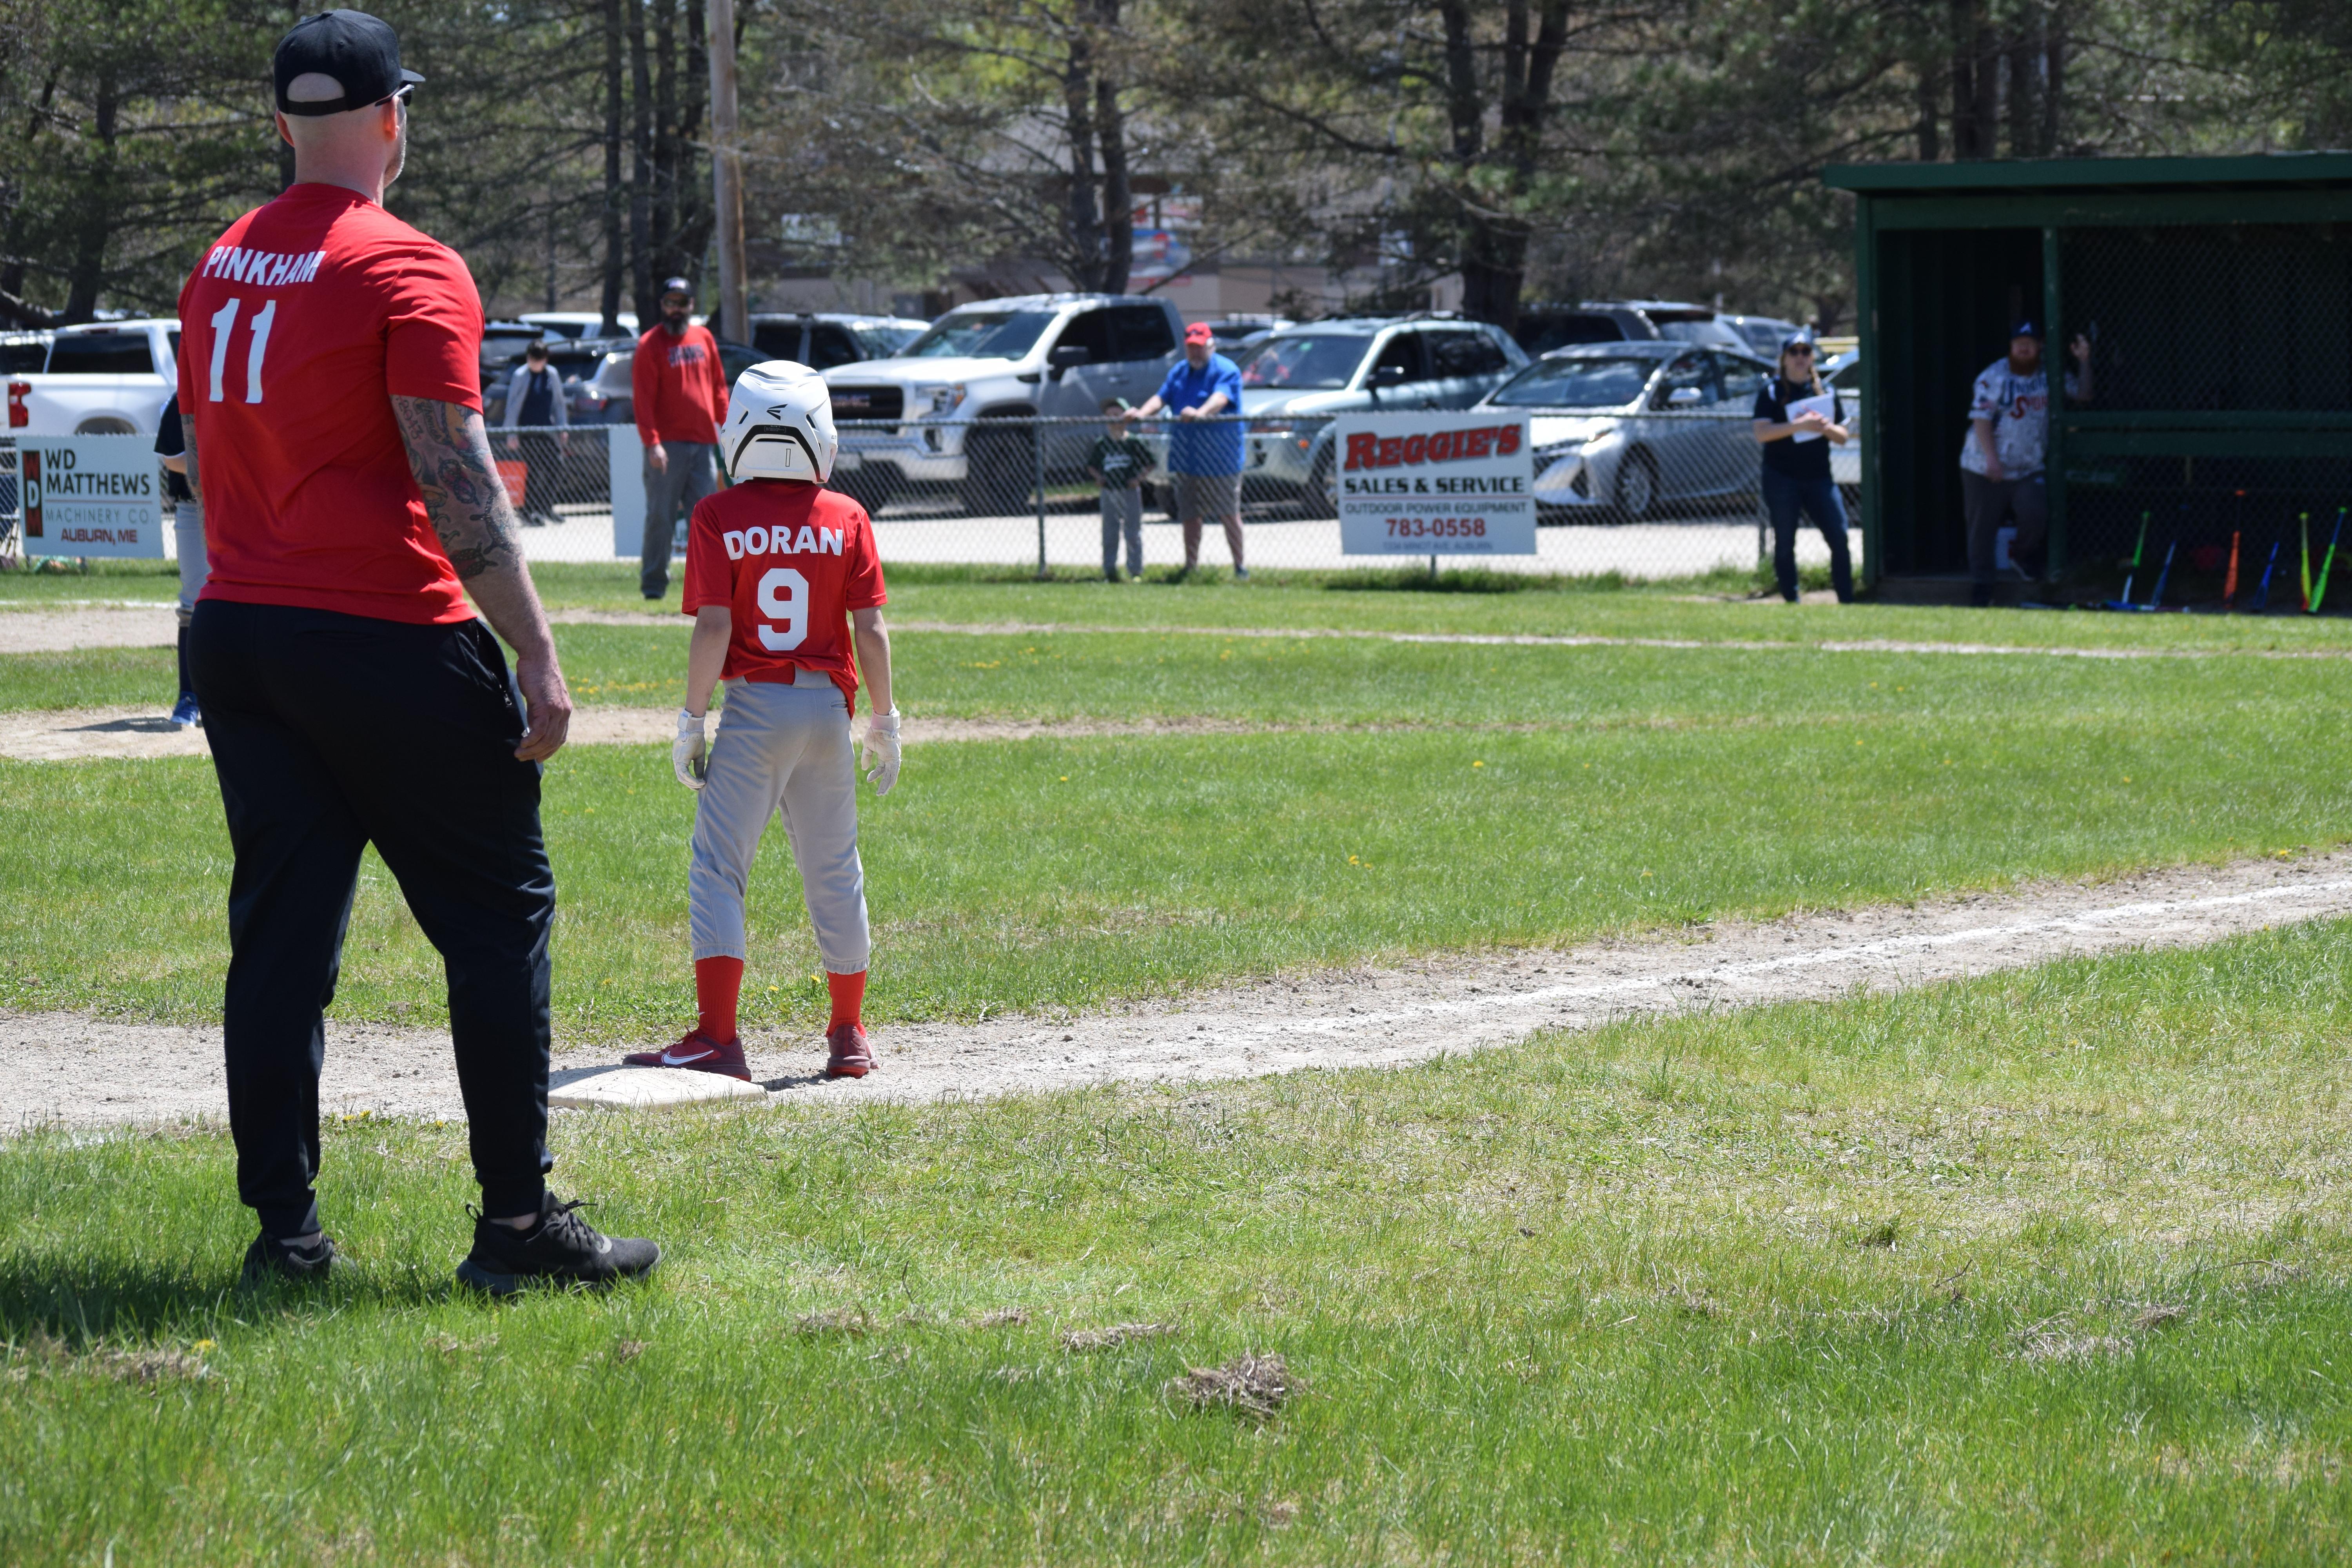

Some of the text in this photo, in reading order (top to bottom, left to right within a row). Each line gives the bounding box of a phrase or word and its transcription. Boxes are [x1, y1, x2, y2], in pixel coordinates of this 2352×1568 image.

[202, 246, 327, 285] PINKHAM
[209, 298, 276, 403] 11
[1345, 423, 1521, 470] REGGIE'S
[45, 449, 76, 469] WD
[46, 473, 151, 495] MATTHEWS
[1345, 476, 1523, 494] SALES & SERVICE
[45, 508, 154, 523] MACHINERY CO.
[1346, 502, 1526, 514] OUTDOOR POWER EQUIPMENT
[61, 529, 138, 544] AUBURN, ME
[1385, 518, 1486, 537] 783-0558
[723, 526, 842, 560] DORAN
[758, 568, 809, 651] 9
